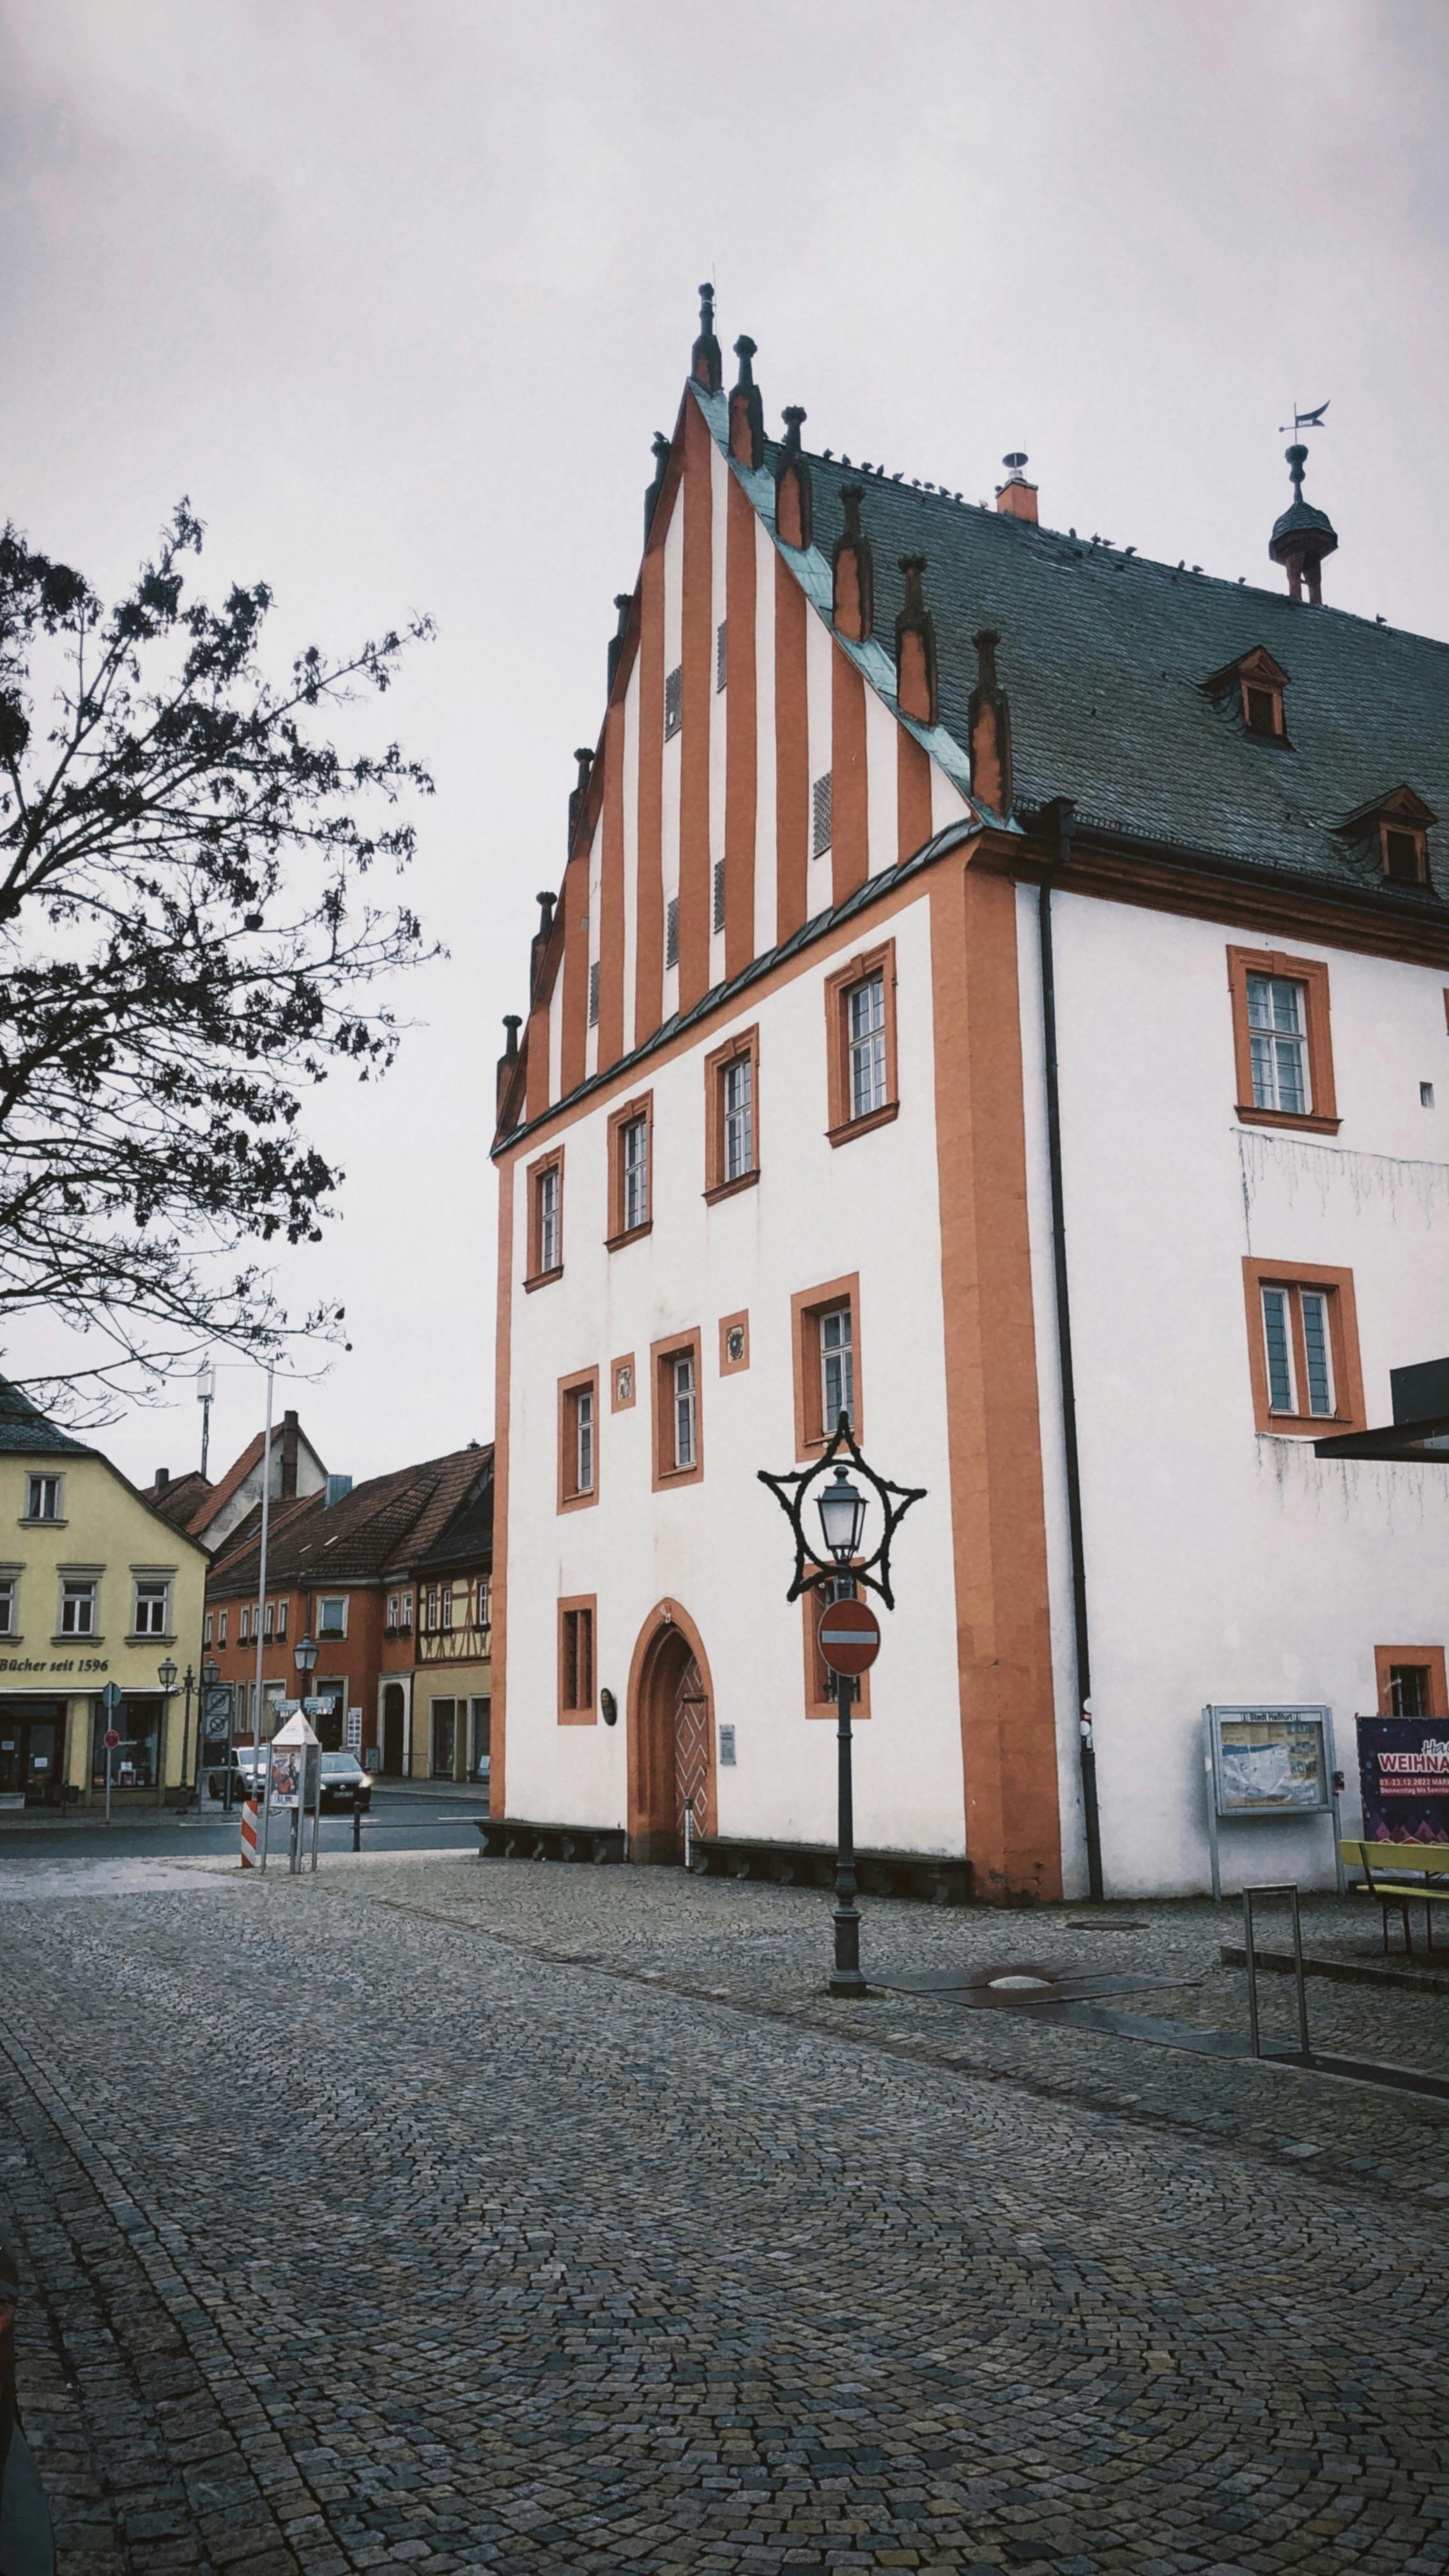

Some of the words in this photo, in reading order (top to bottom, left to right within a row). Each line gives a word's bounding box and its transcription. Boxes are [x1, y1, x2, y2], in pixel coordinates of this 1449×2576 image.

[0, 1659, 47, 1672] Bücher
[50, 1659, 74, 1672] seit
[77, 1659, 109, 1672] 1596
